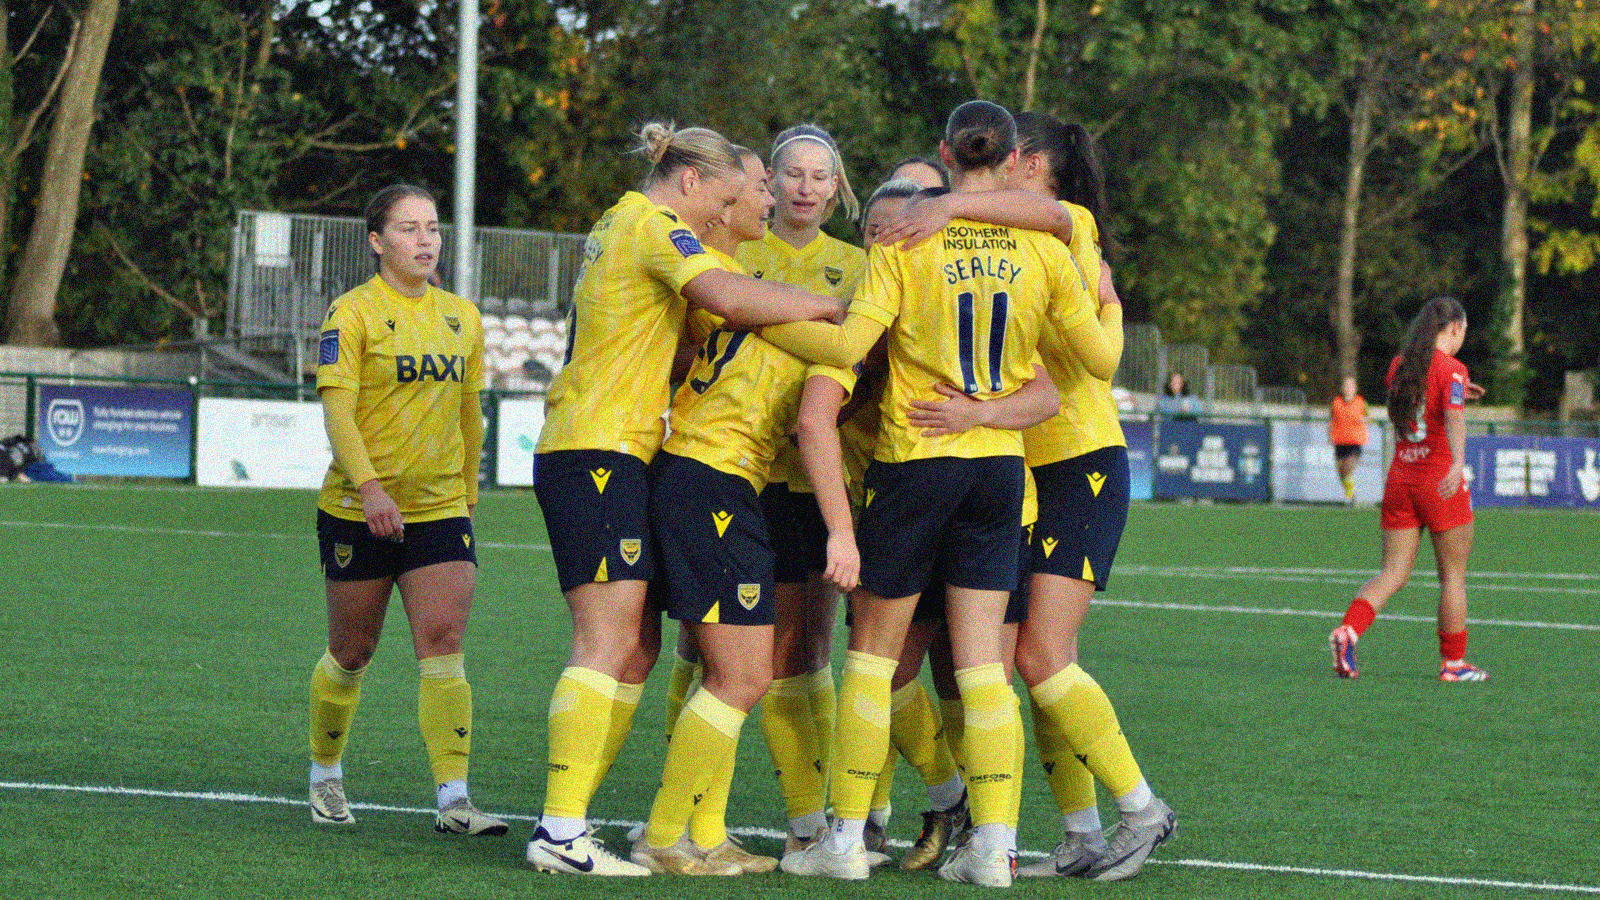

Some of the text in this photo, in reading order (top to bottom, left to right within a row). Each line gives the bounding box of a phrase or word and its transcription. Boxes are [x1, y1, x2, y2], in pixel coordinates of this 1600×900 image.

[943, 238, 1018, 251] INSULATION
[946, 226, 1009, 239] ISOTHERM
[943, 255, 1022, 285] SEALEY
[957, 291, 1009, 395] 11
[395, 353, 466, 384] BAXI
